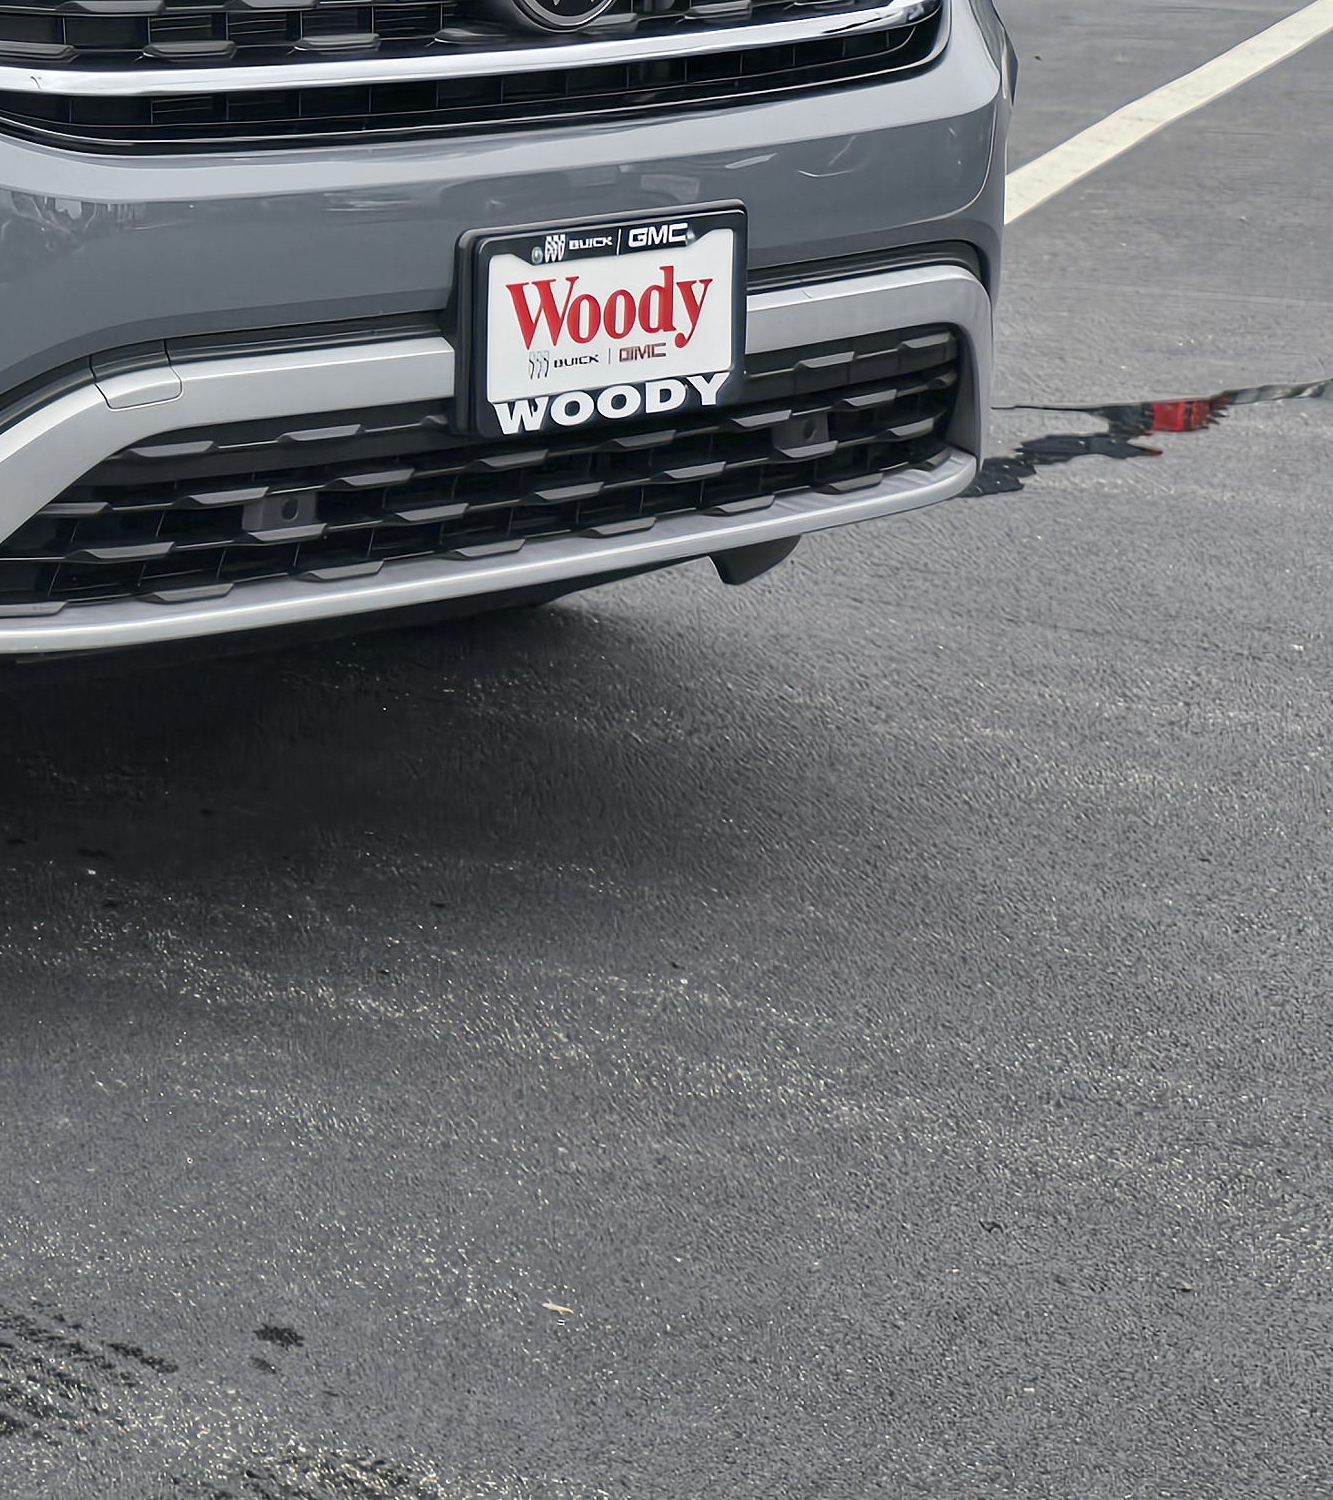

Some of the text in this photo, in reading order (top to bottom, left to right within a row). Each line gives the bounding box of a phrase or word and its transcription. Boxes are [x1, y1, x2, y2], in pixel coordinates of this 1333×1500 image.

[568, 222, 689, 251] BUICK GMC
[505, 265, 714, 351] Woody
[553, 342, 667, 369] BUICK GMC
[493, 371, 731, 435] WOODY
